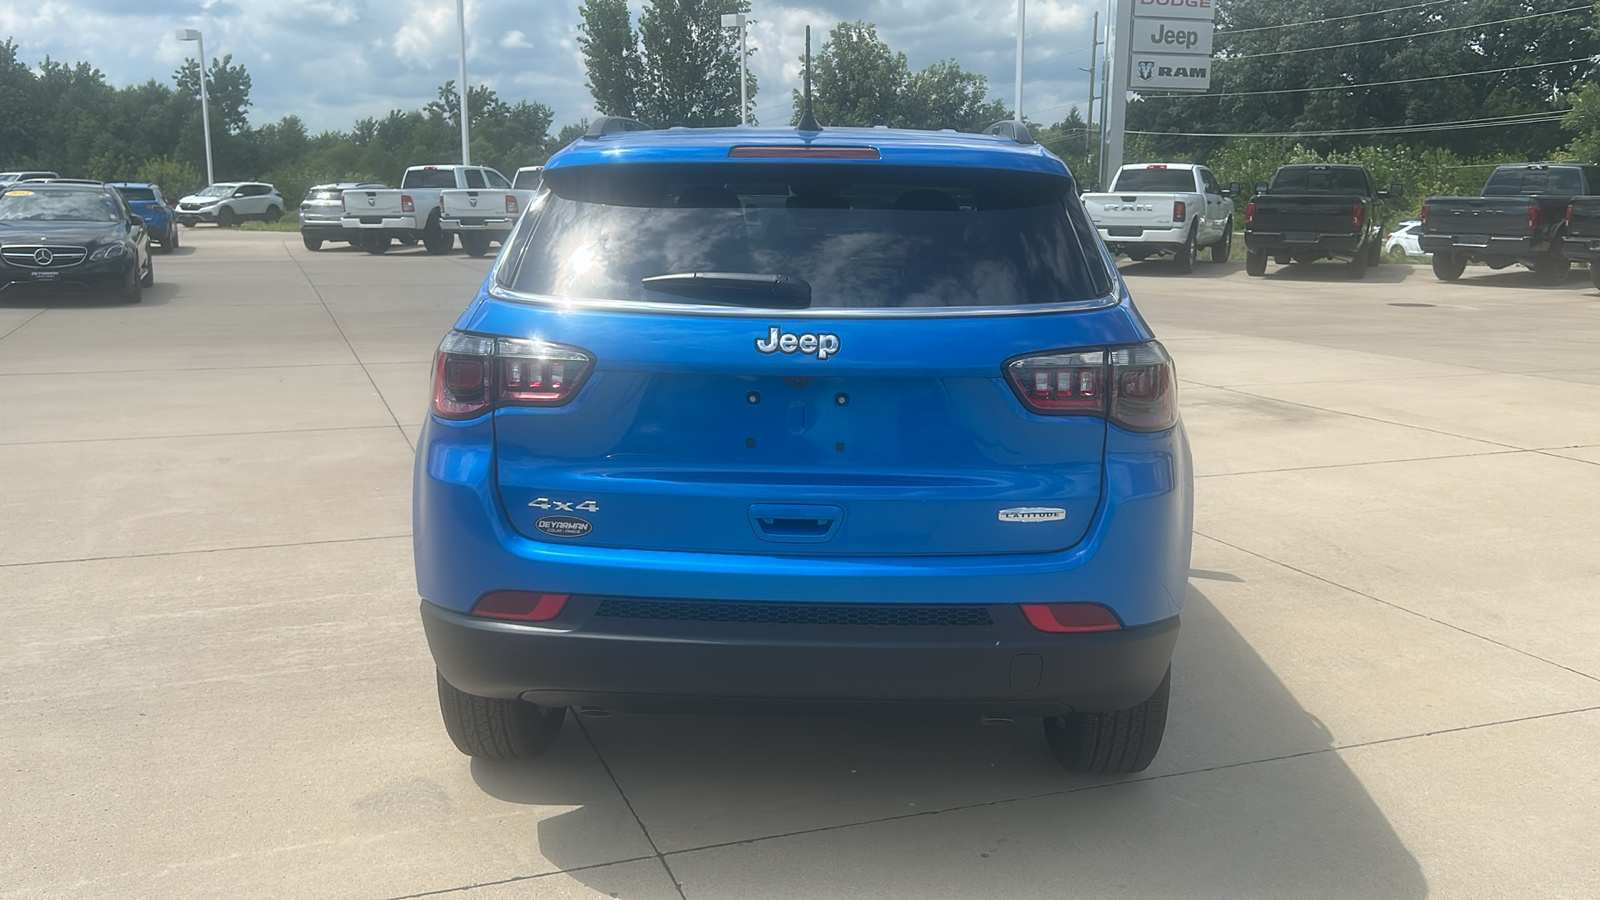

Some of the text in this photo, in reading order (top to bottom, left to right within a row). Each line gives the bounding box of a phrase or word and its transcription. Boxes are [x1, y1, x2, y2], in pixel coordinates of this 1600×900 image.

[1150, 24, 1198, 49] Jeep
[1158, 66, 1207, 78] RAM
[1104, 204, 1153, 212] RAM
[755, 326, 840, 360] Jeep
[528, 497, 600, 513] 4x4
[1004, 511, 1060, 519] LATITUDE
[538, 520, 589, 531] DEYARMAN
